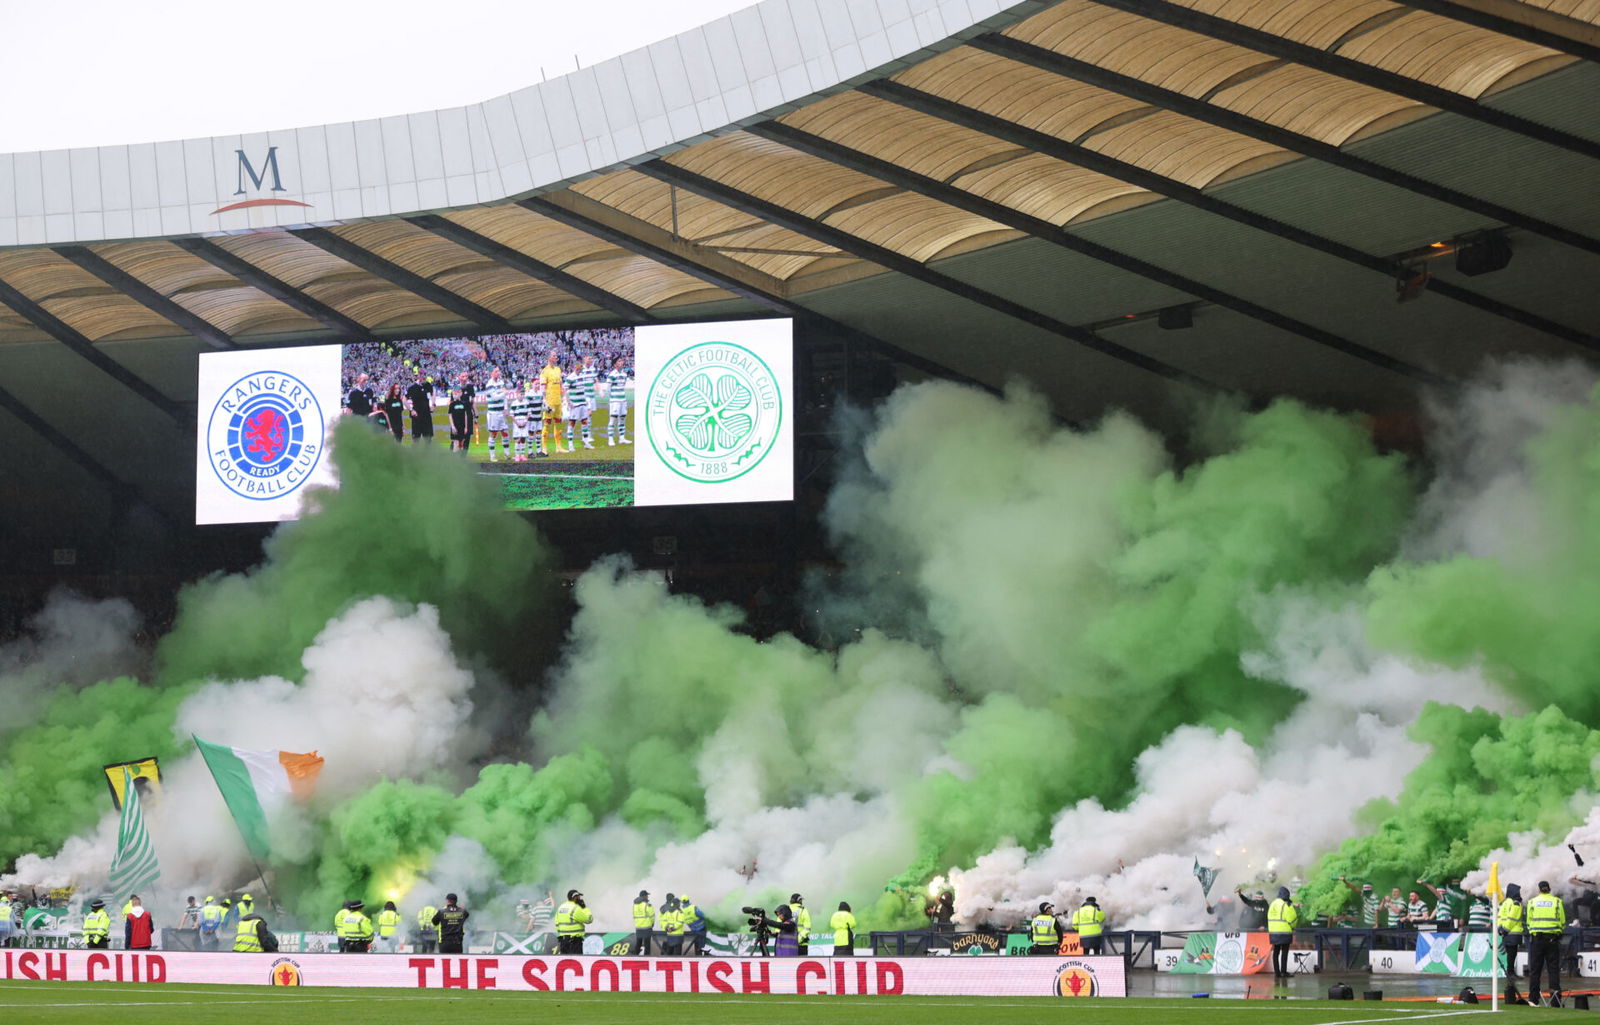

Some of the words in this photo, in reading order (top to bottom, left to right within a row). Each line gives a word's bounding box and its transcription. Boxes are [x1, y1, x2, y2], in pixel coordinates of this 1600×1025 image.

[233, 146, 287, 196] M
[653, 392, 668, 416] THE
[666, 355, 697, 388] CELTIC
[698, 349, 758, 377] FOOTBALL
[755, 377, 775, 410] CLUB
[222, 376, 311, 413] RANGERS
[215, 449, 286, 494] FOOTBALL
[287, 444, 316, 483] CLUB
[249, 465, 280, 477] READY
[700, 462, 728, 475] 1888
[611, 943, 630, 955] 88
[1061, 942, 1079, 954] OW
[5, 952, 67, 980] ISH
[87, 954, 166, 982] CUP
[291, 960, 301, 969] CUP
[1056, 960, 1083, 973] SCOTTISH
[1083, 963, 1095, 973] CUP
[1166, 955, 1178, 967] 39
[1381, 957, 1393, 969] 40
[1588, 959, 1597, 972] 41
[409, 959, 499, 989] THE
[522, 959, 770, 993] SCOTTISH
[797, 961, 904, 994] CUP
